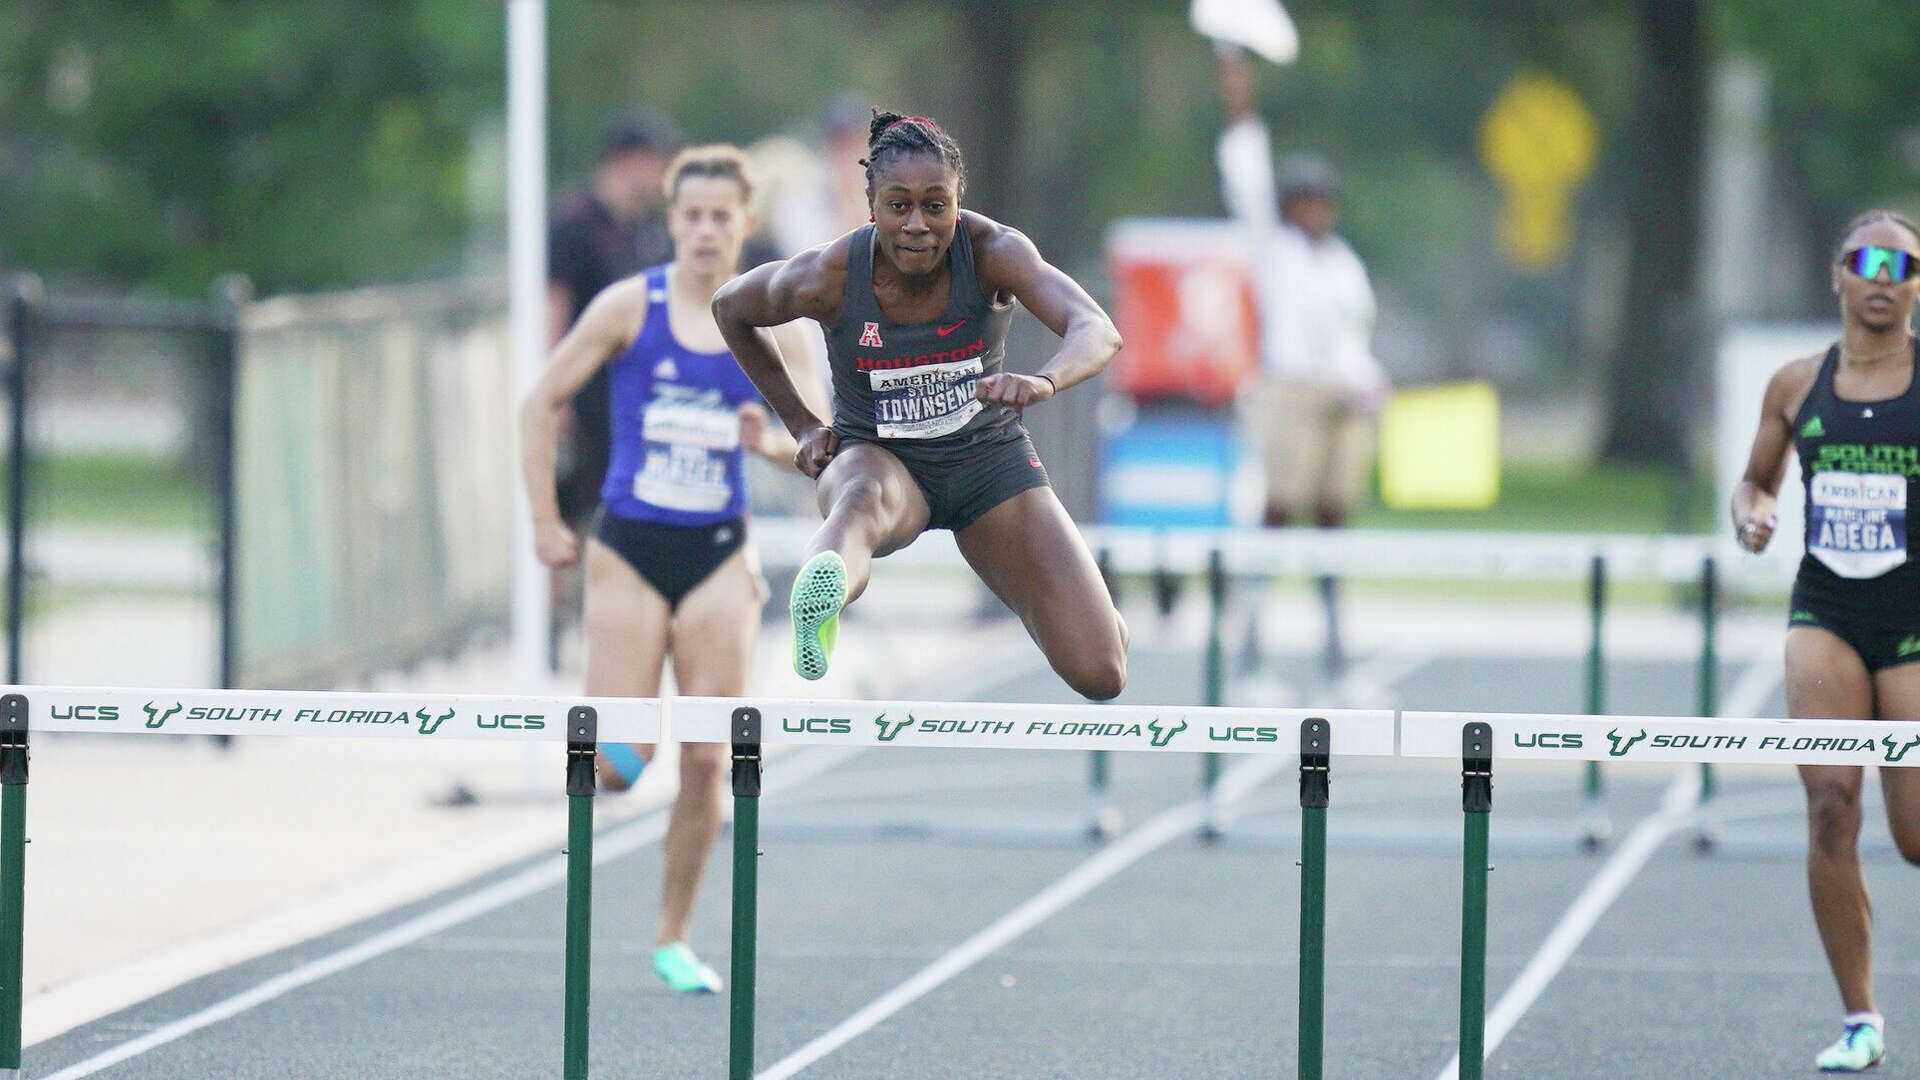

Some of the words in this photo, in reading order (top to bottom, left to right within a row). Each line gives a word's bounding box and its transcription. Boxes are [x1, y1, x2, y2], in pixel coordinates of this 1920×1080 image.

[856, 337, 985, 371] HOUSTON
[879, 379, 977, 422] TOWNSEND
[1818, 444, 1918, 463] SOUTH
[1818, 521, 1897, 550] ABEGA
[50, 705, 119, 721] UCS
[186, 707, 282, 722] SOUTH
[294, 709, 409, 725] FLORIDA
[477, 714, 545, 730] UCS
[783, 718, 851, 734] UCS
[918, 719, 1015, 734] SOUTH
[1026, 721, 1142, 737] FLORIDA
[1209, 726, 1278, 742] UCS
[1514, 732, 1583, 749] UCS
[1651, 734, 1748, 750] SOUTH
[1759, 736, 1876, 752] FLORIDA
